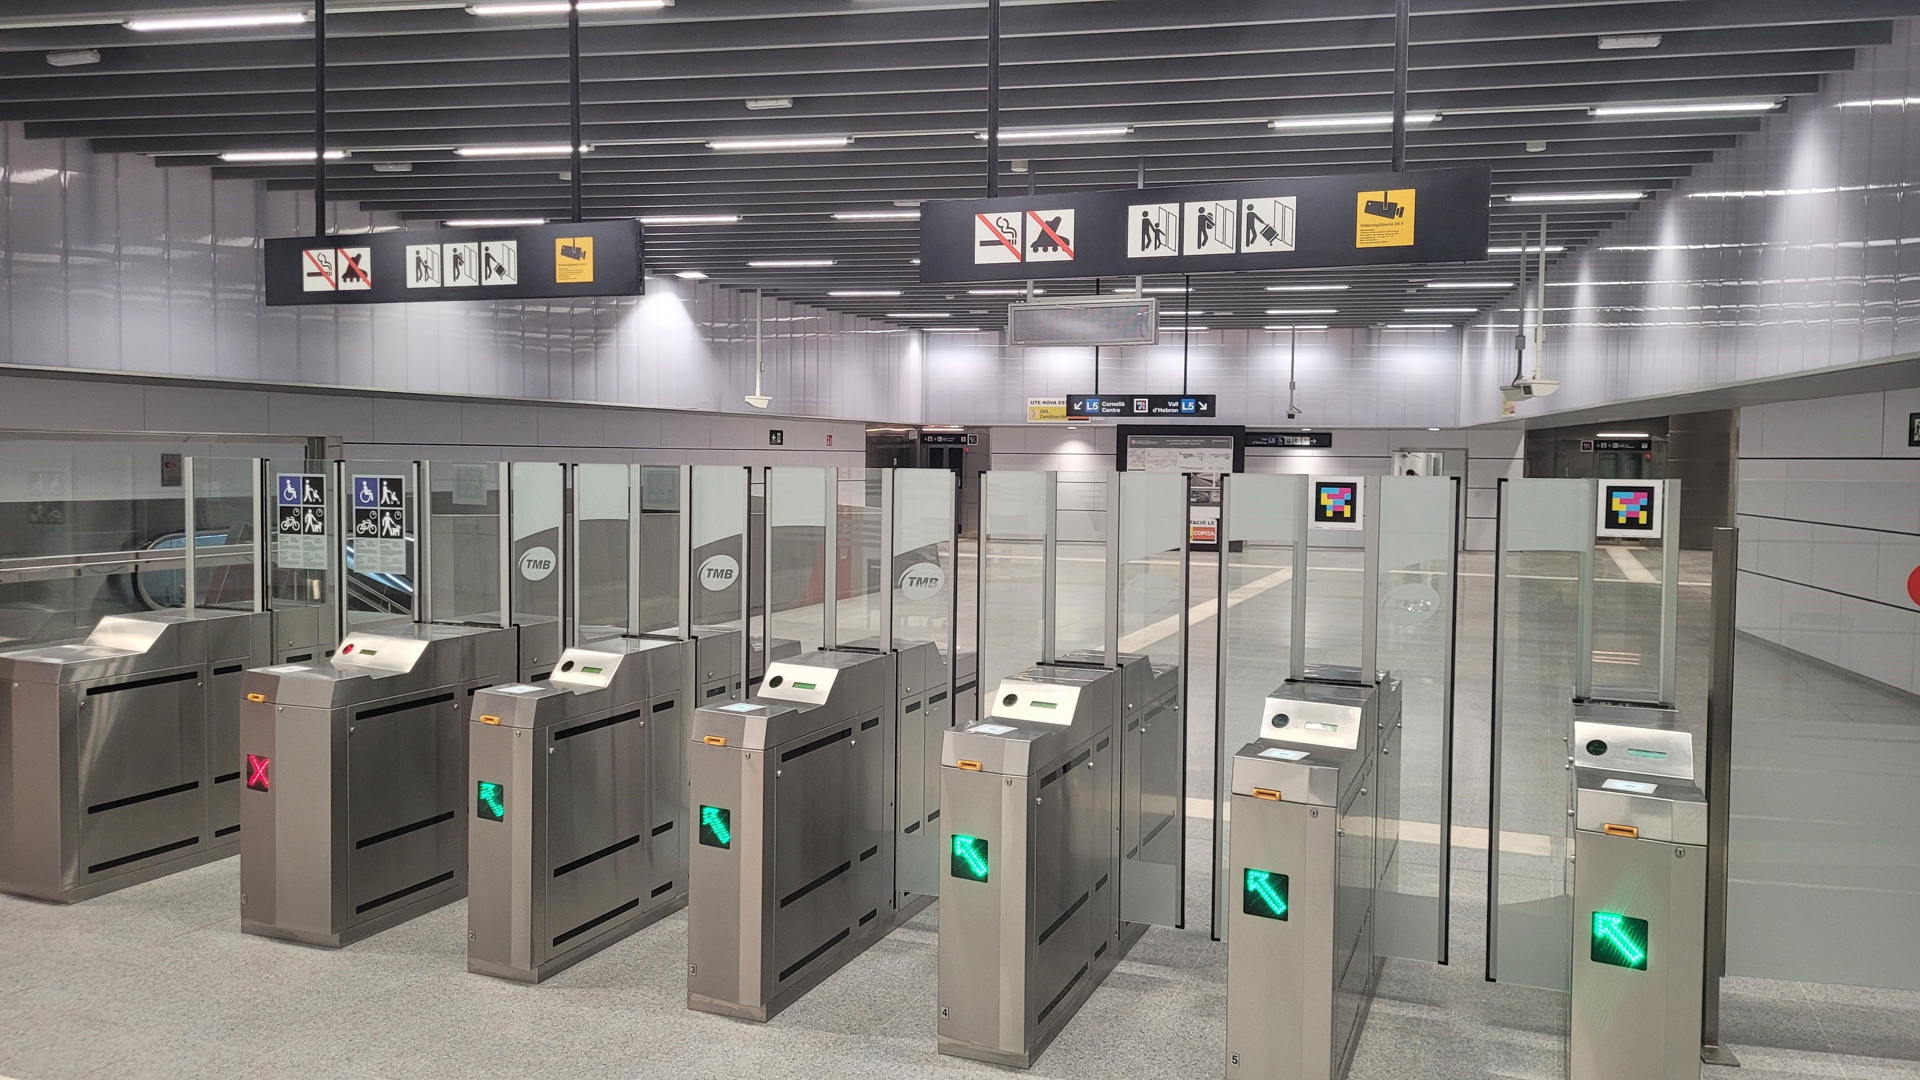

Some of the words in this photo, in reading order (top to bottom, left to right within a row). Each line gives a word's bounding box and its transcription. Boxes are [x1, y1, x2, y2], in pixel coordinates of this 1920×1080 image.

[1086, 401, 1098, 411] L5
[1182, 401, 1195, 411] L5
[526, 559, 551, 570] TMB
[706, 568, 734, 579] TMB
[908, 576, 939, 588] TMB
[1231, 1055, 1238, 1065] 5
